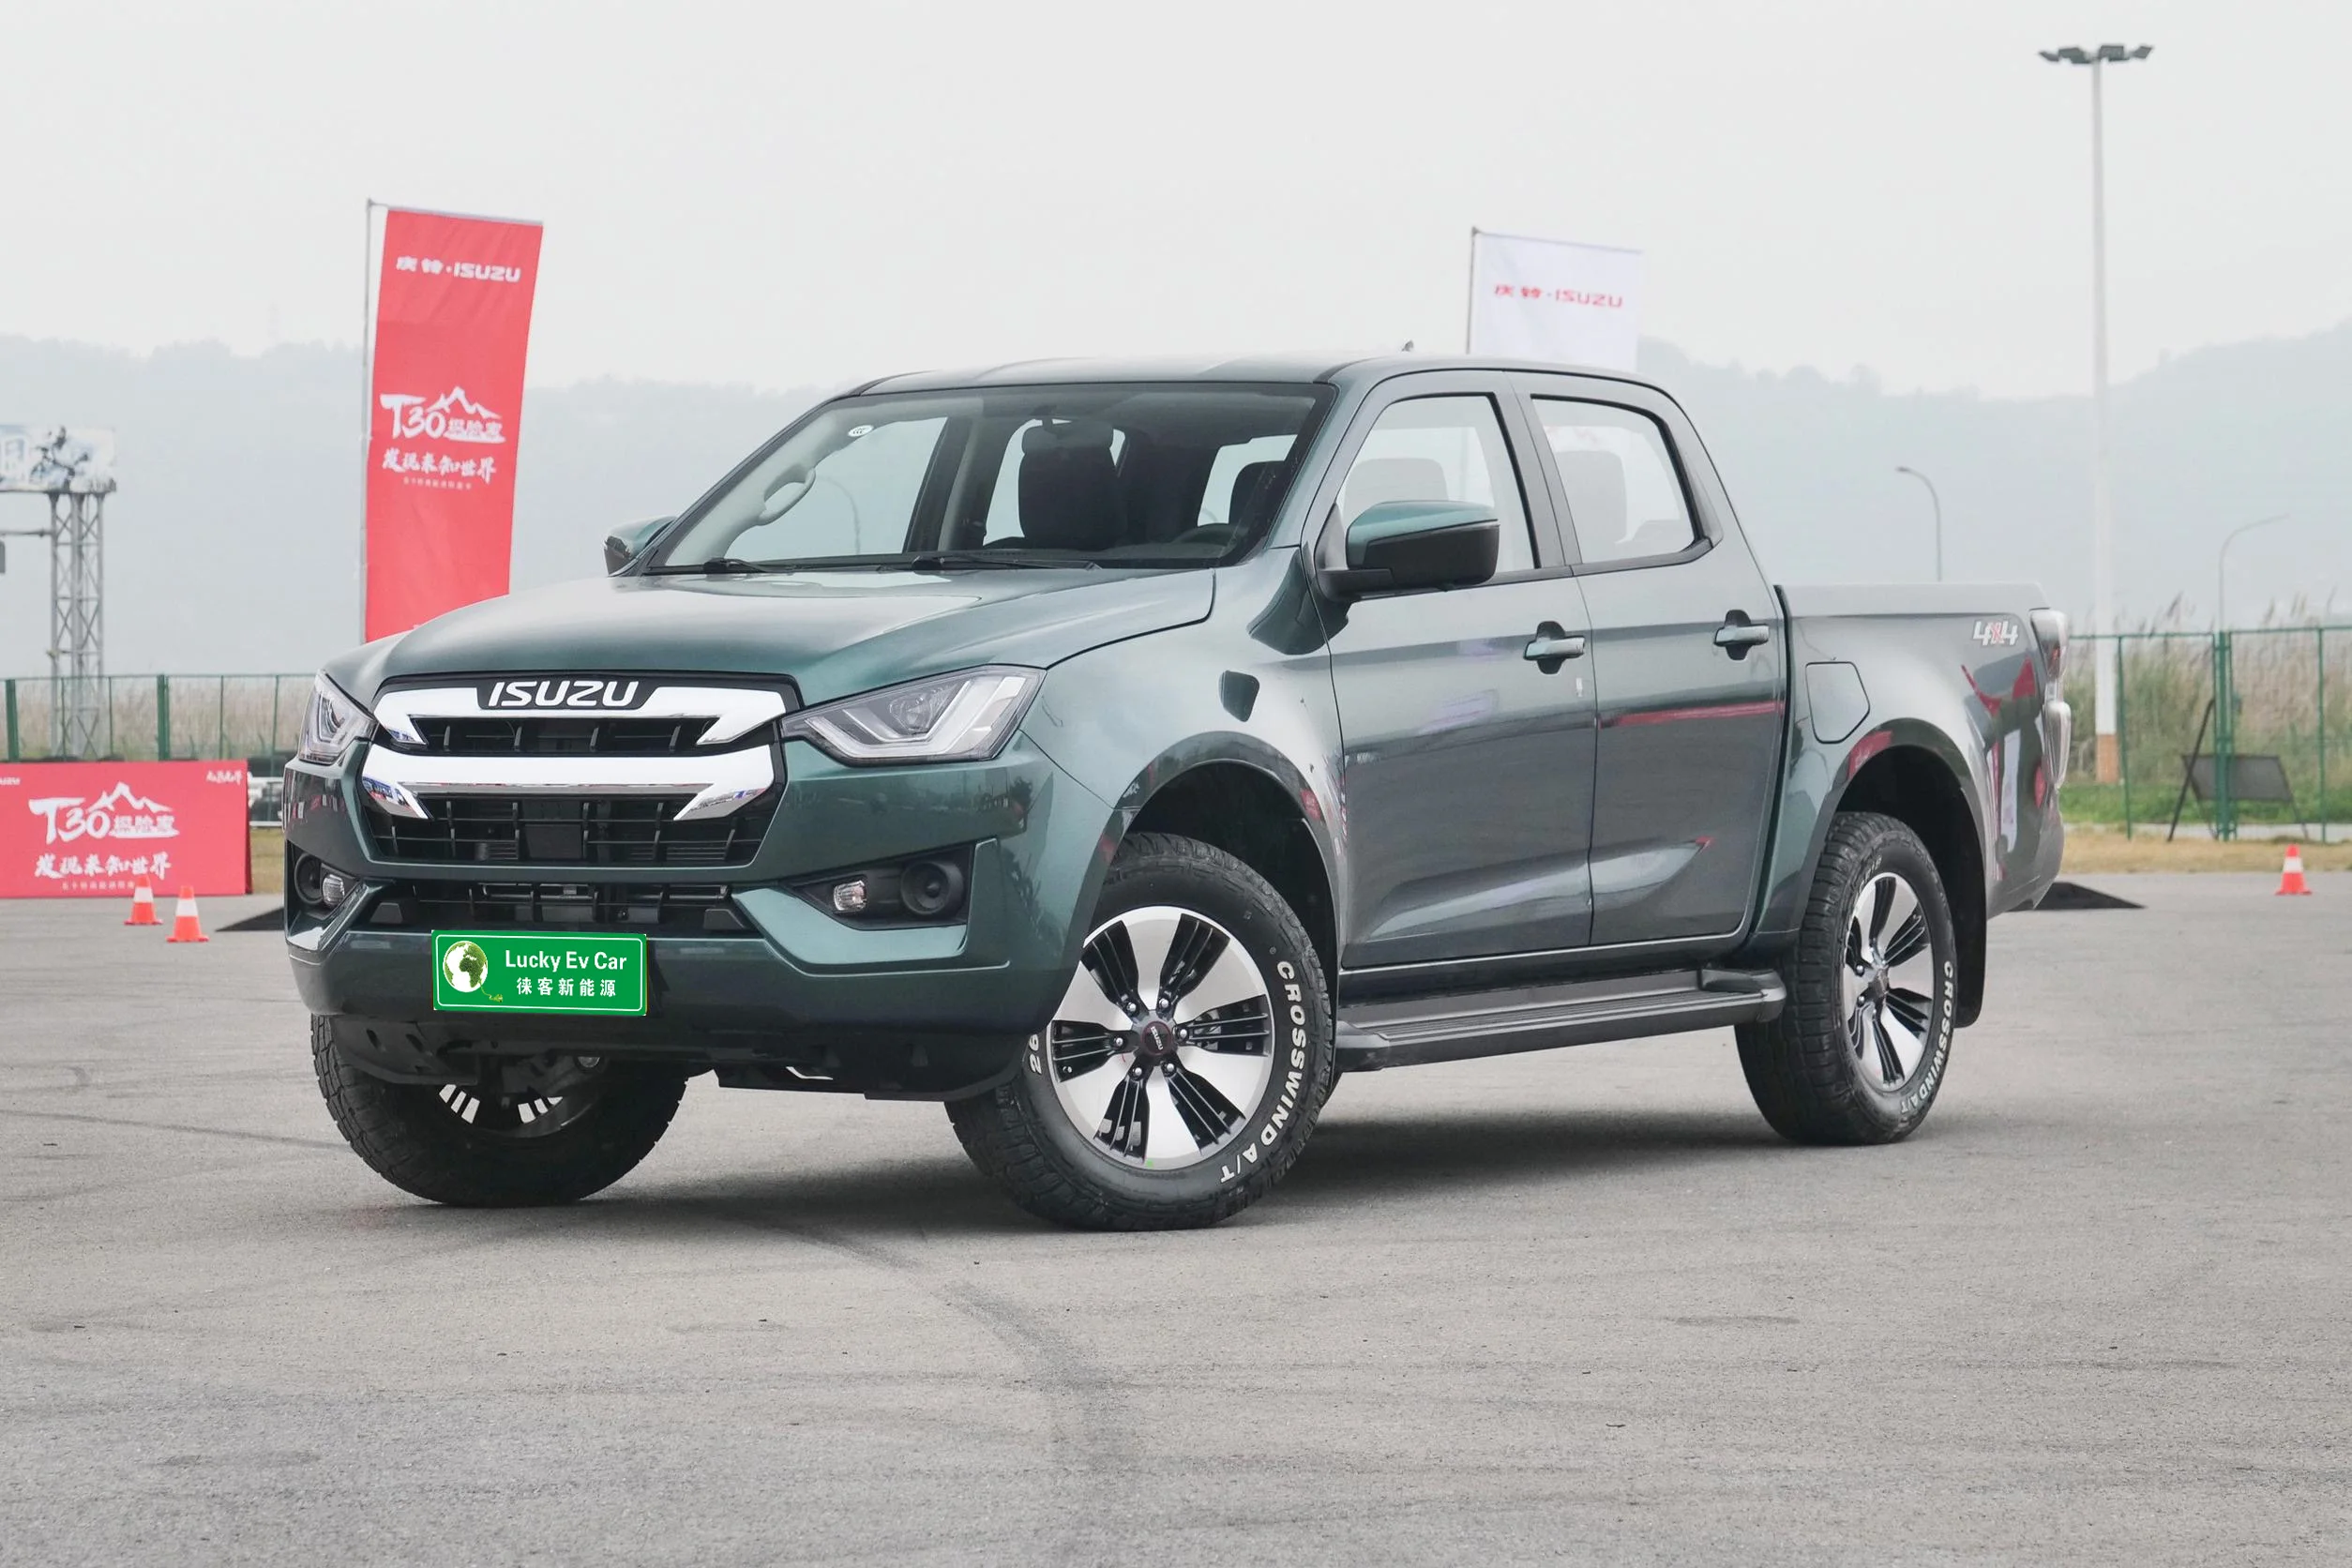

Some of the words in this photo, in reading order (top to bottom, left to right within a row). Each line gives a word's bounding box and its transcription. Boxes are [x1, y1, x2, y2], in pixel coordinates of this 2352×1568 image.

[380, 393, 446, 439] T30
[488, 680, 640, 707] ISUZU
[28, 797, 111, 844] T30
[505, 949, 561, 972] Lucky
[565, 951, 590, 970] Ev
[594, 951, 627, 971] Car
[516, 976, 616, 998] 徕客新能源
[1919, 960, 1954, 1101] CROSSWIND
[1260, 960, 1307, 1146] CROSSWIND
[1220, 1142, 1259, 1184] A/T
